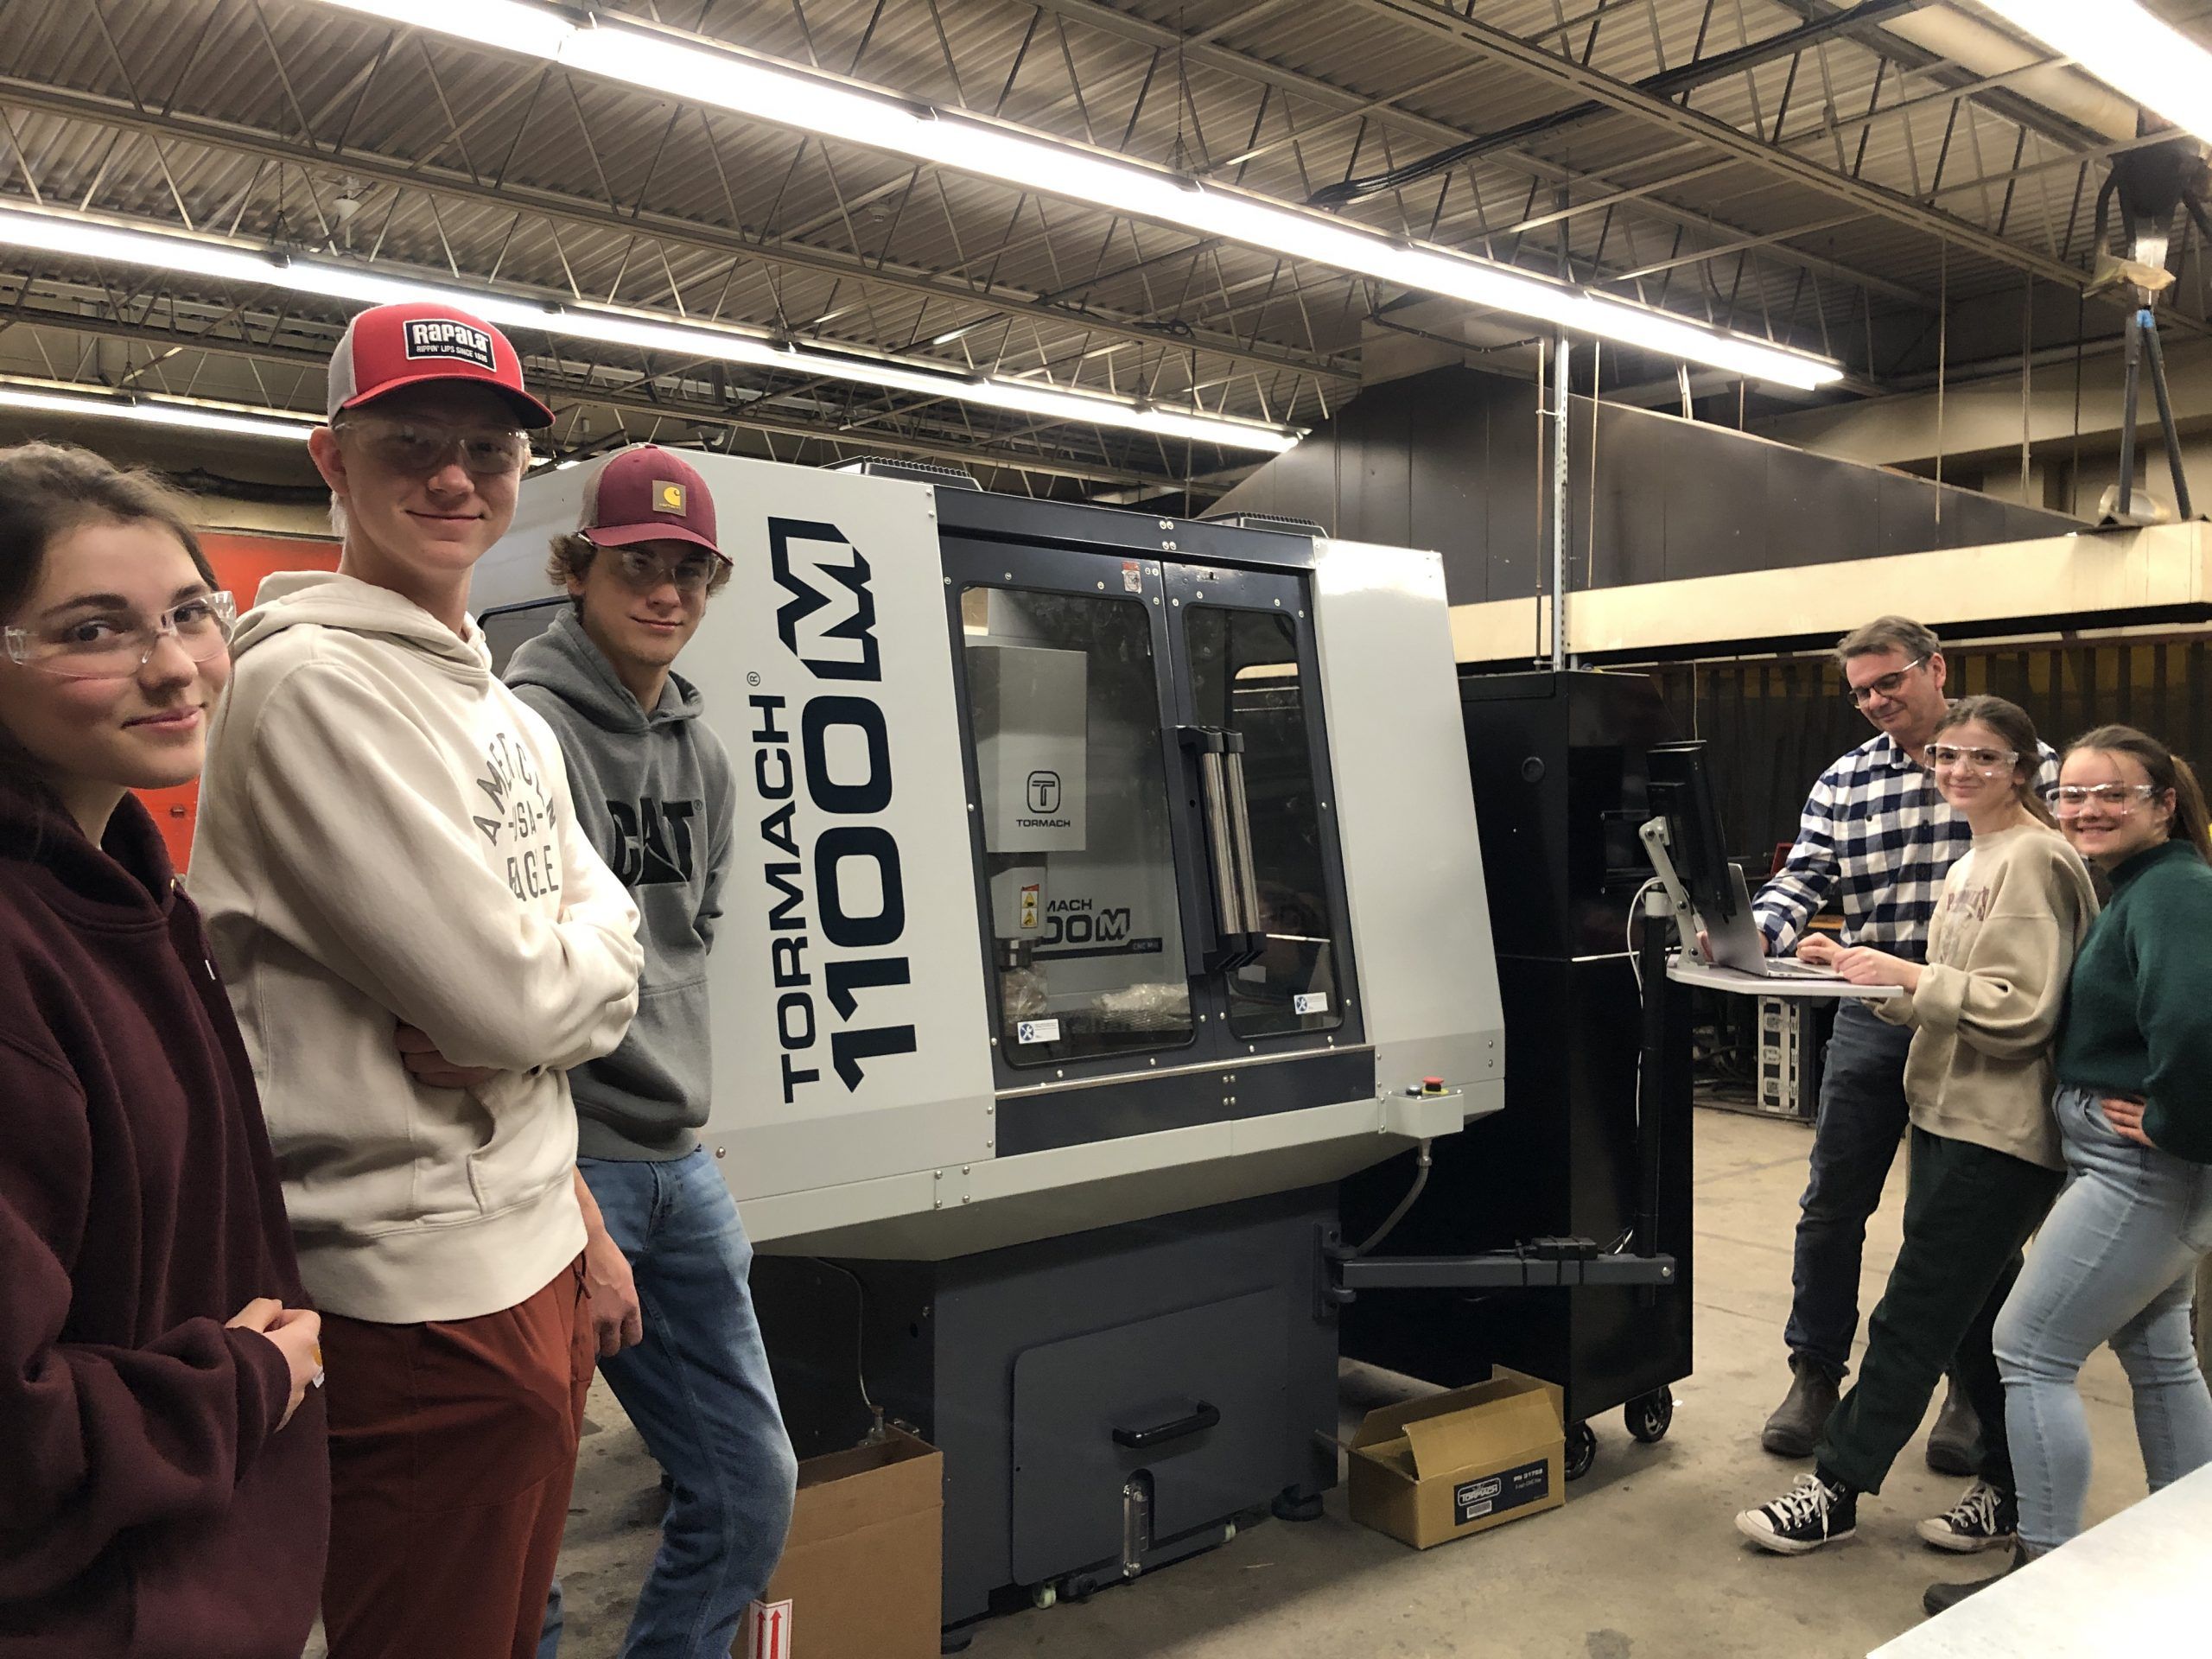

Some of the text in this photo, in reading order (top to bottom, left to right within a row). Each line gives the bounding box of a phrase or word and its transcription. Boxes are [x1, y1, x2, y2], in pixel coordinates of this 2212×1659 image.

[441, 345, 454, 353] LIPS
[455, 346, 474, 358] SINCE
[473, 733, 556, 847] AMECN
[768, 516, 918, 1094] 1100M
[1016, 819, 1071, 828] TORMACH
[748, 694, 820, 1104] TORMACH
[1460, 1484, 1498, 1503] TORMACH
